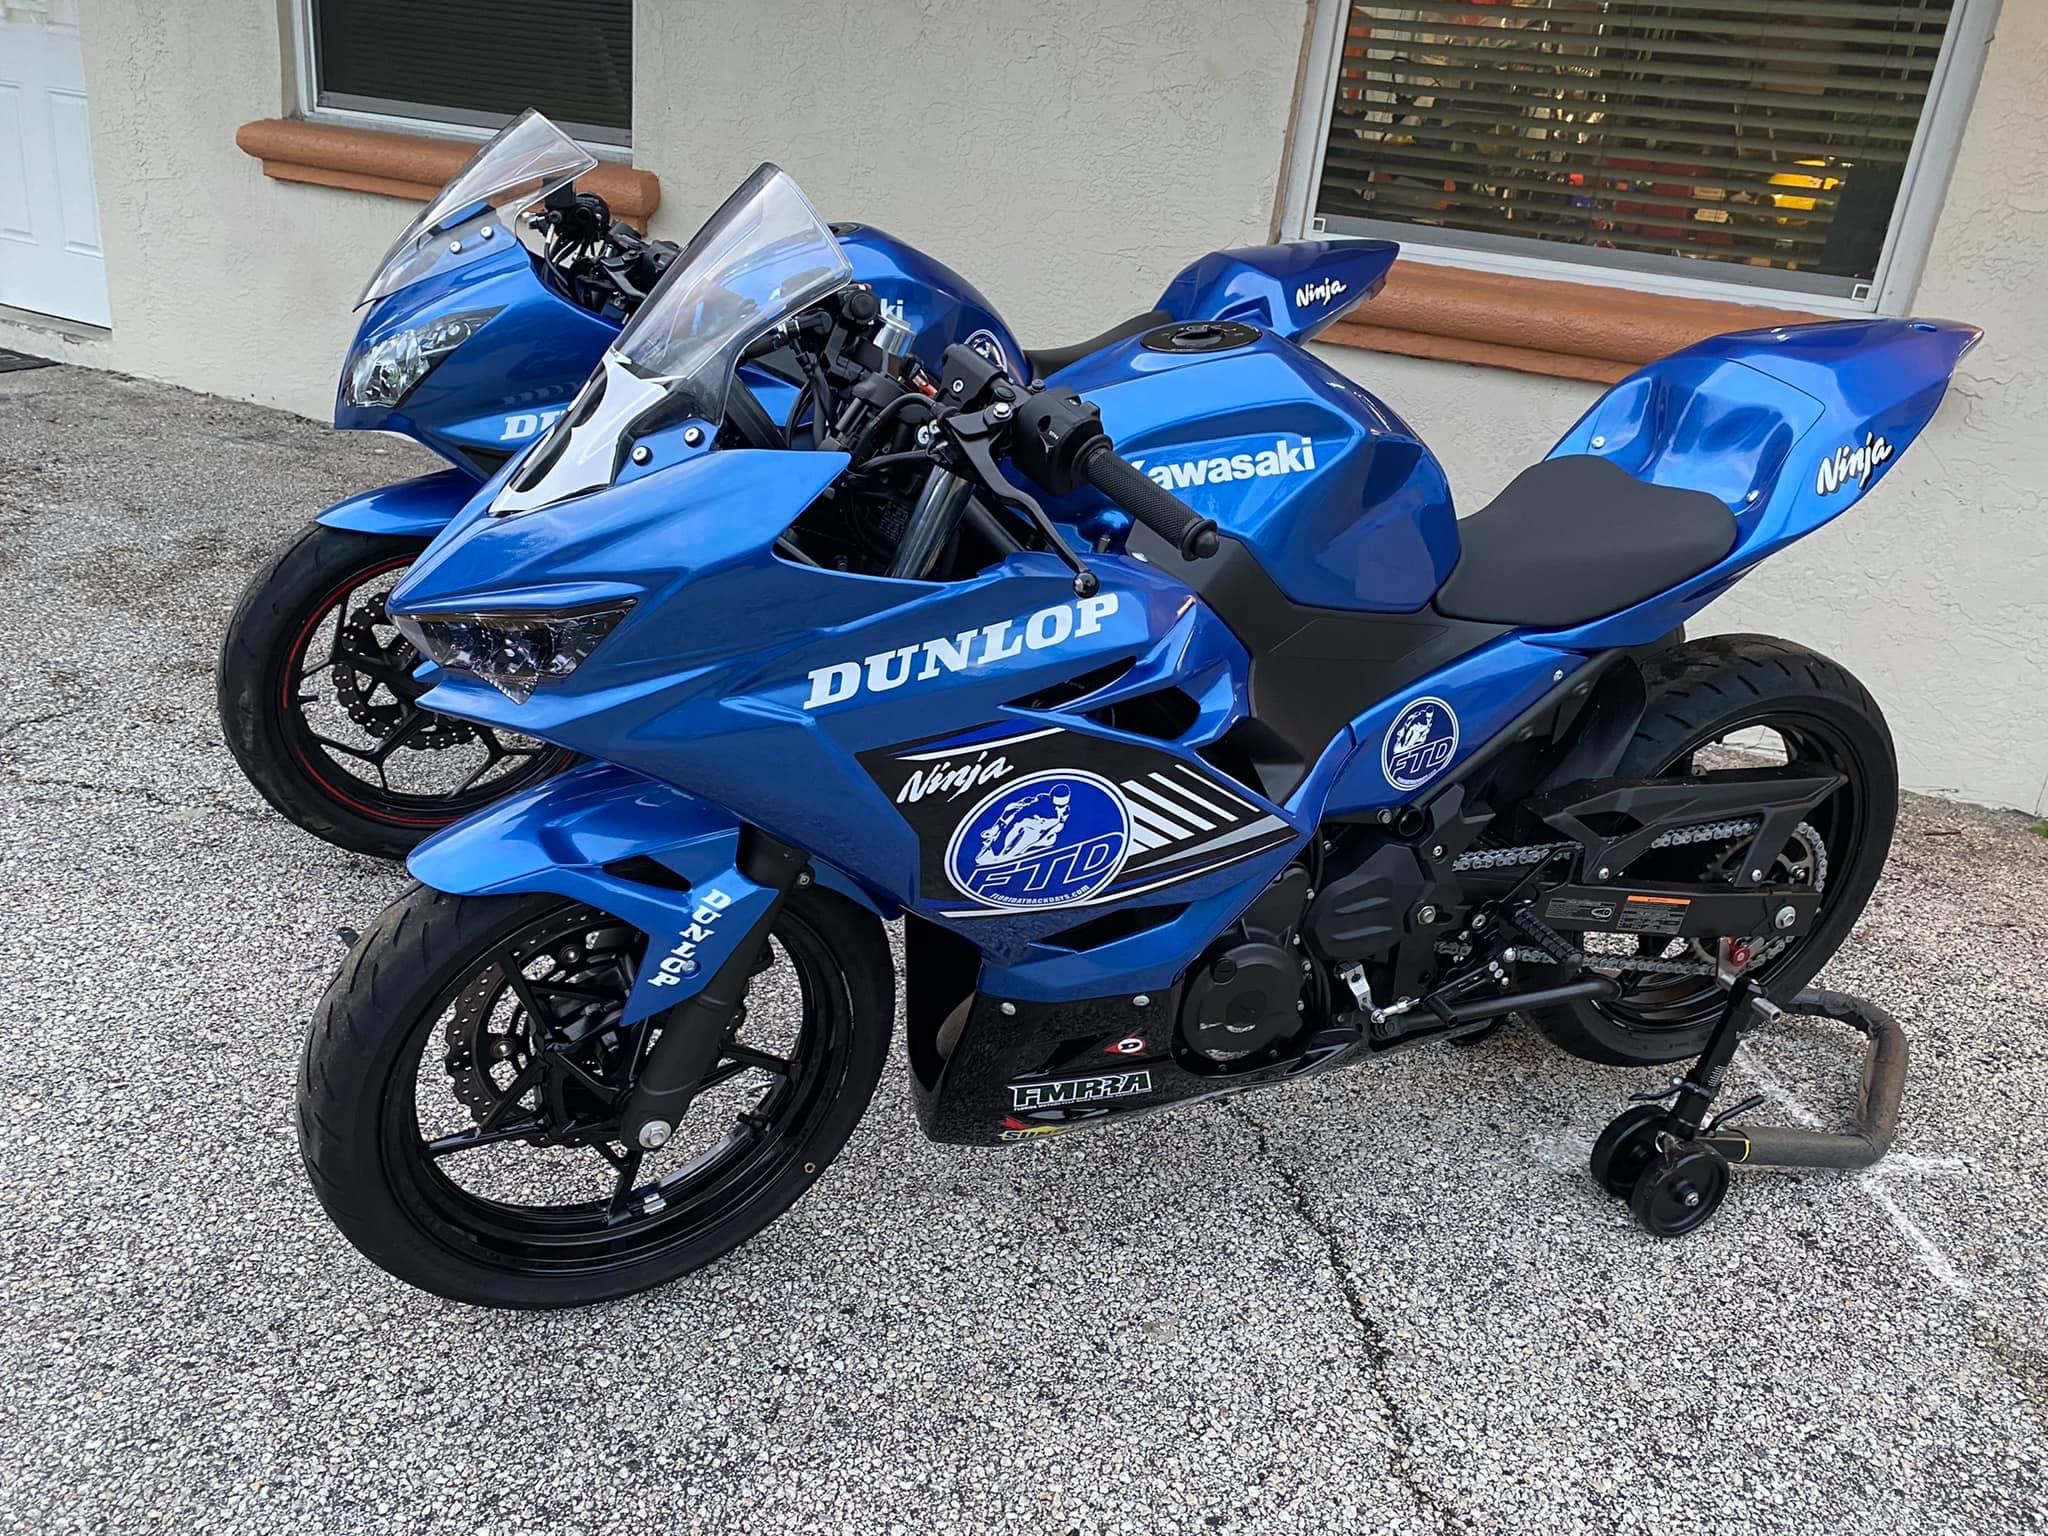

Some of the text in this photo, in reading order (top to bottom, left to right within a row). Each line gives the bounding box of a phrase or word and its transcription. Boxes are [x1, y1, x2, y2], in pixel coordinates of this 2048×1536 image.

[1296, 277, 1347, 307] Ninja
[1131, 437, 1316, 491] awasaki
[1816, 431, 1893, 494] Ninja
[803, 593, 1119, 710] DUNLOP
[896, 752, 1014, 803] Ninja
[1388, 736, 1455, 779] FTD
[966, 832, 1125, 895] FTD
[648, 888, 732, 987] DUNLOP
